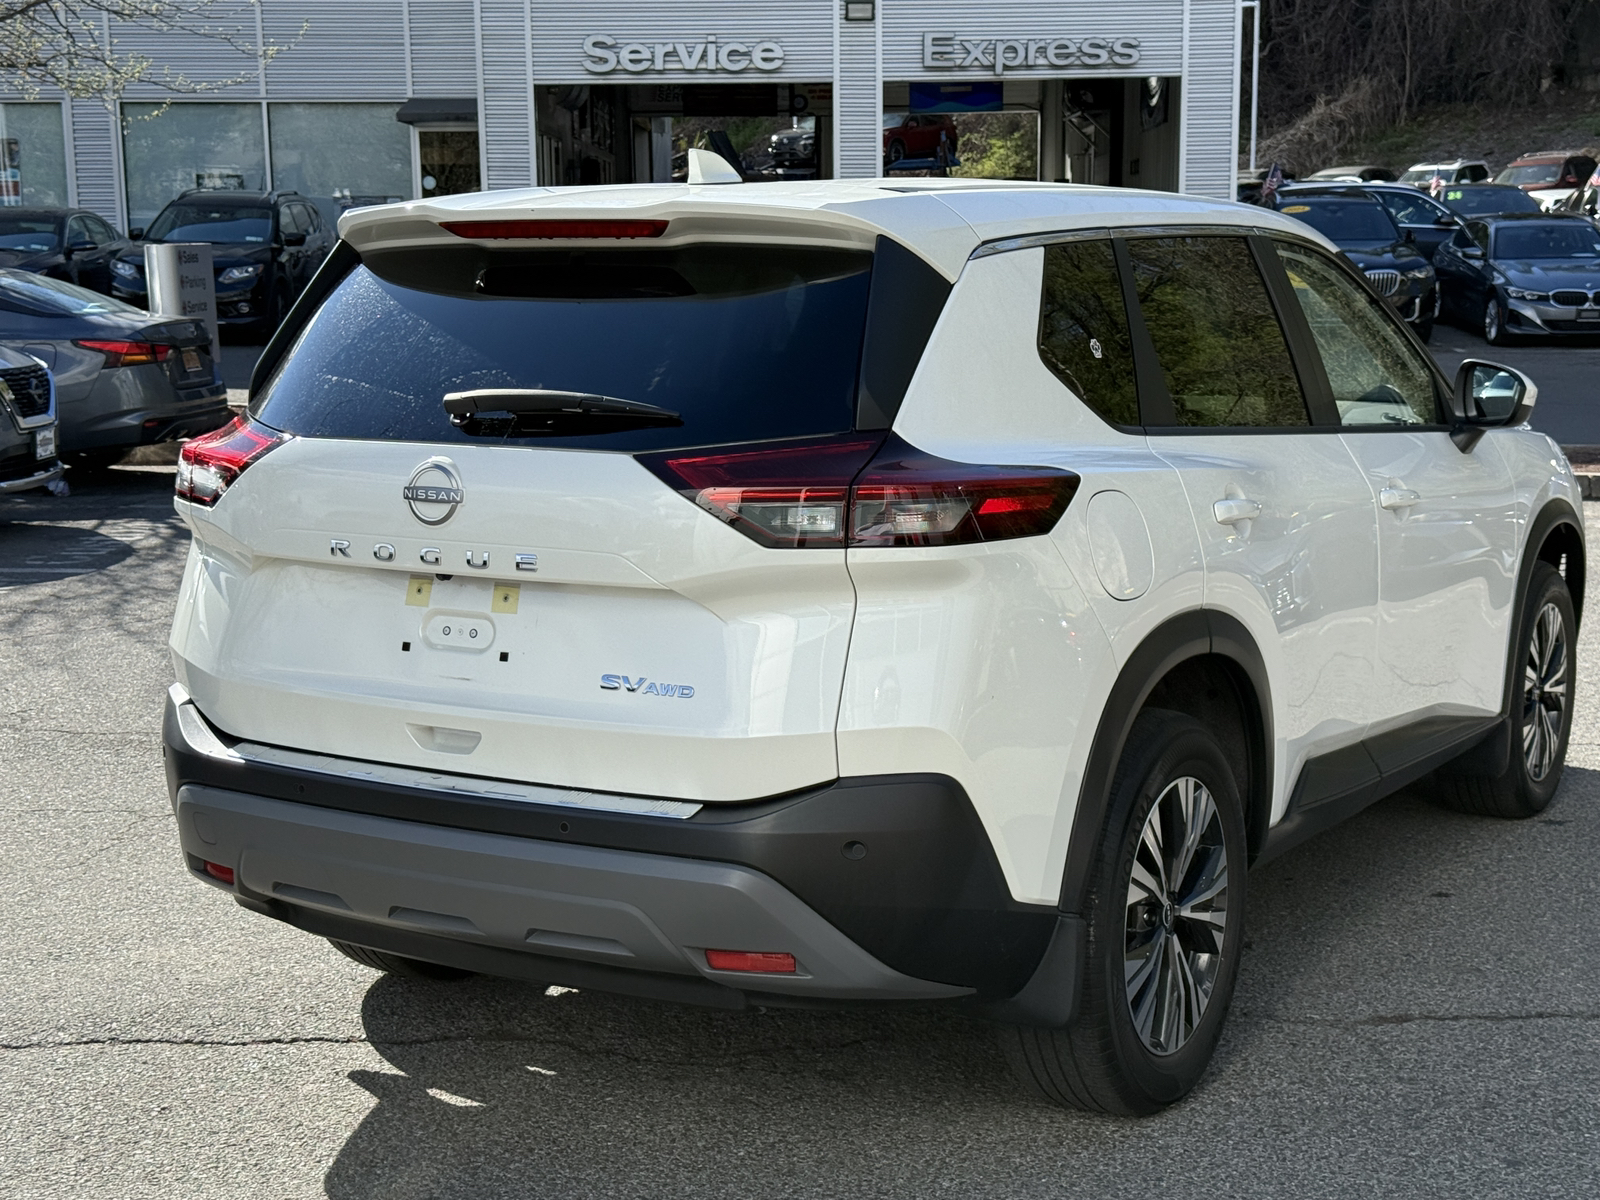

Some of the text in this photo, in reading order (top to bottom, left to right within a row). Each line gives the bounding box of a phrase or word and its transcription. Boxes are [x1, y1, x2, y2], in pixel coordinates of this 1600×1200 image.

[581, 31, 1141, 76] Service Express
[183, 250, 199, 264] Sales
[185, 275, 207, 291] Parking
[187, 301, 208, 314] Service
[404, 488, 461, 501] NISSAN
[330, 538, 539, 573] ROGUE
